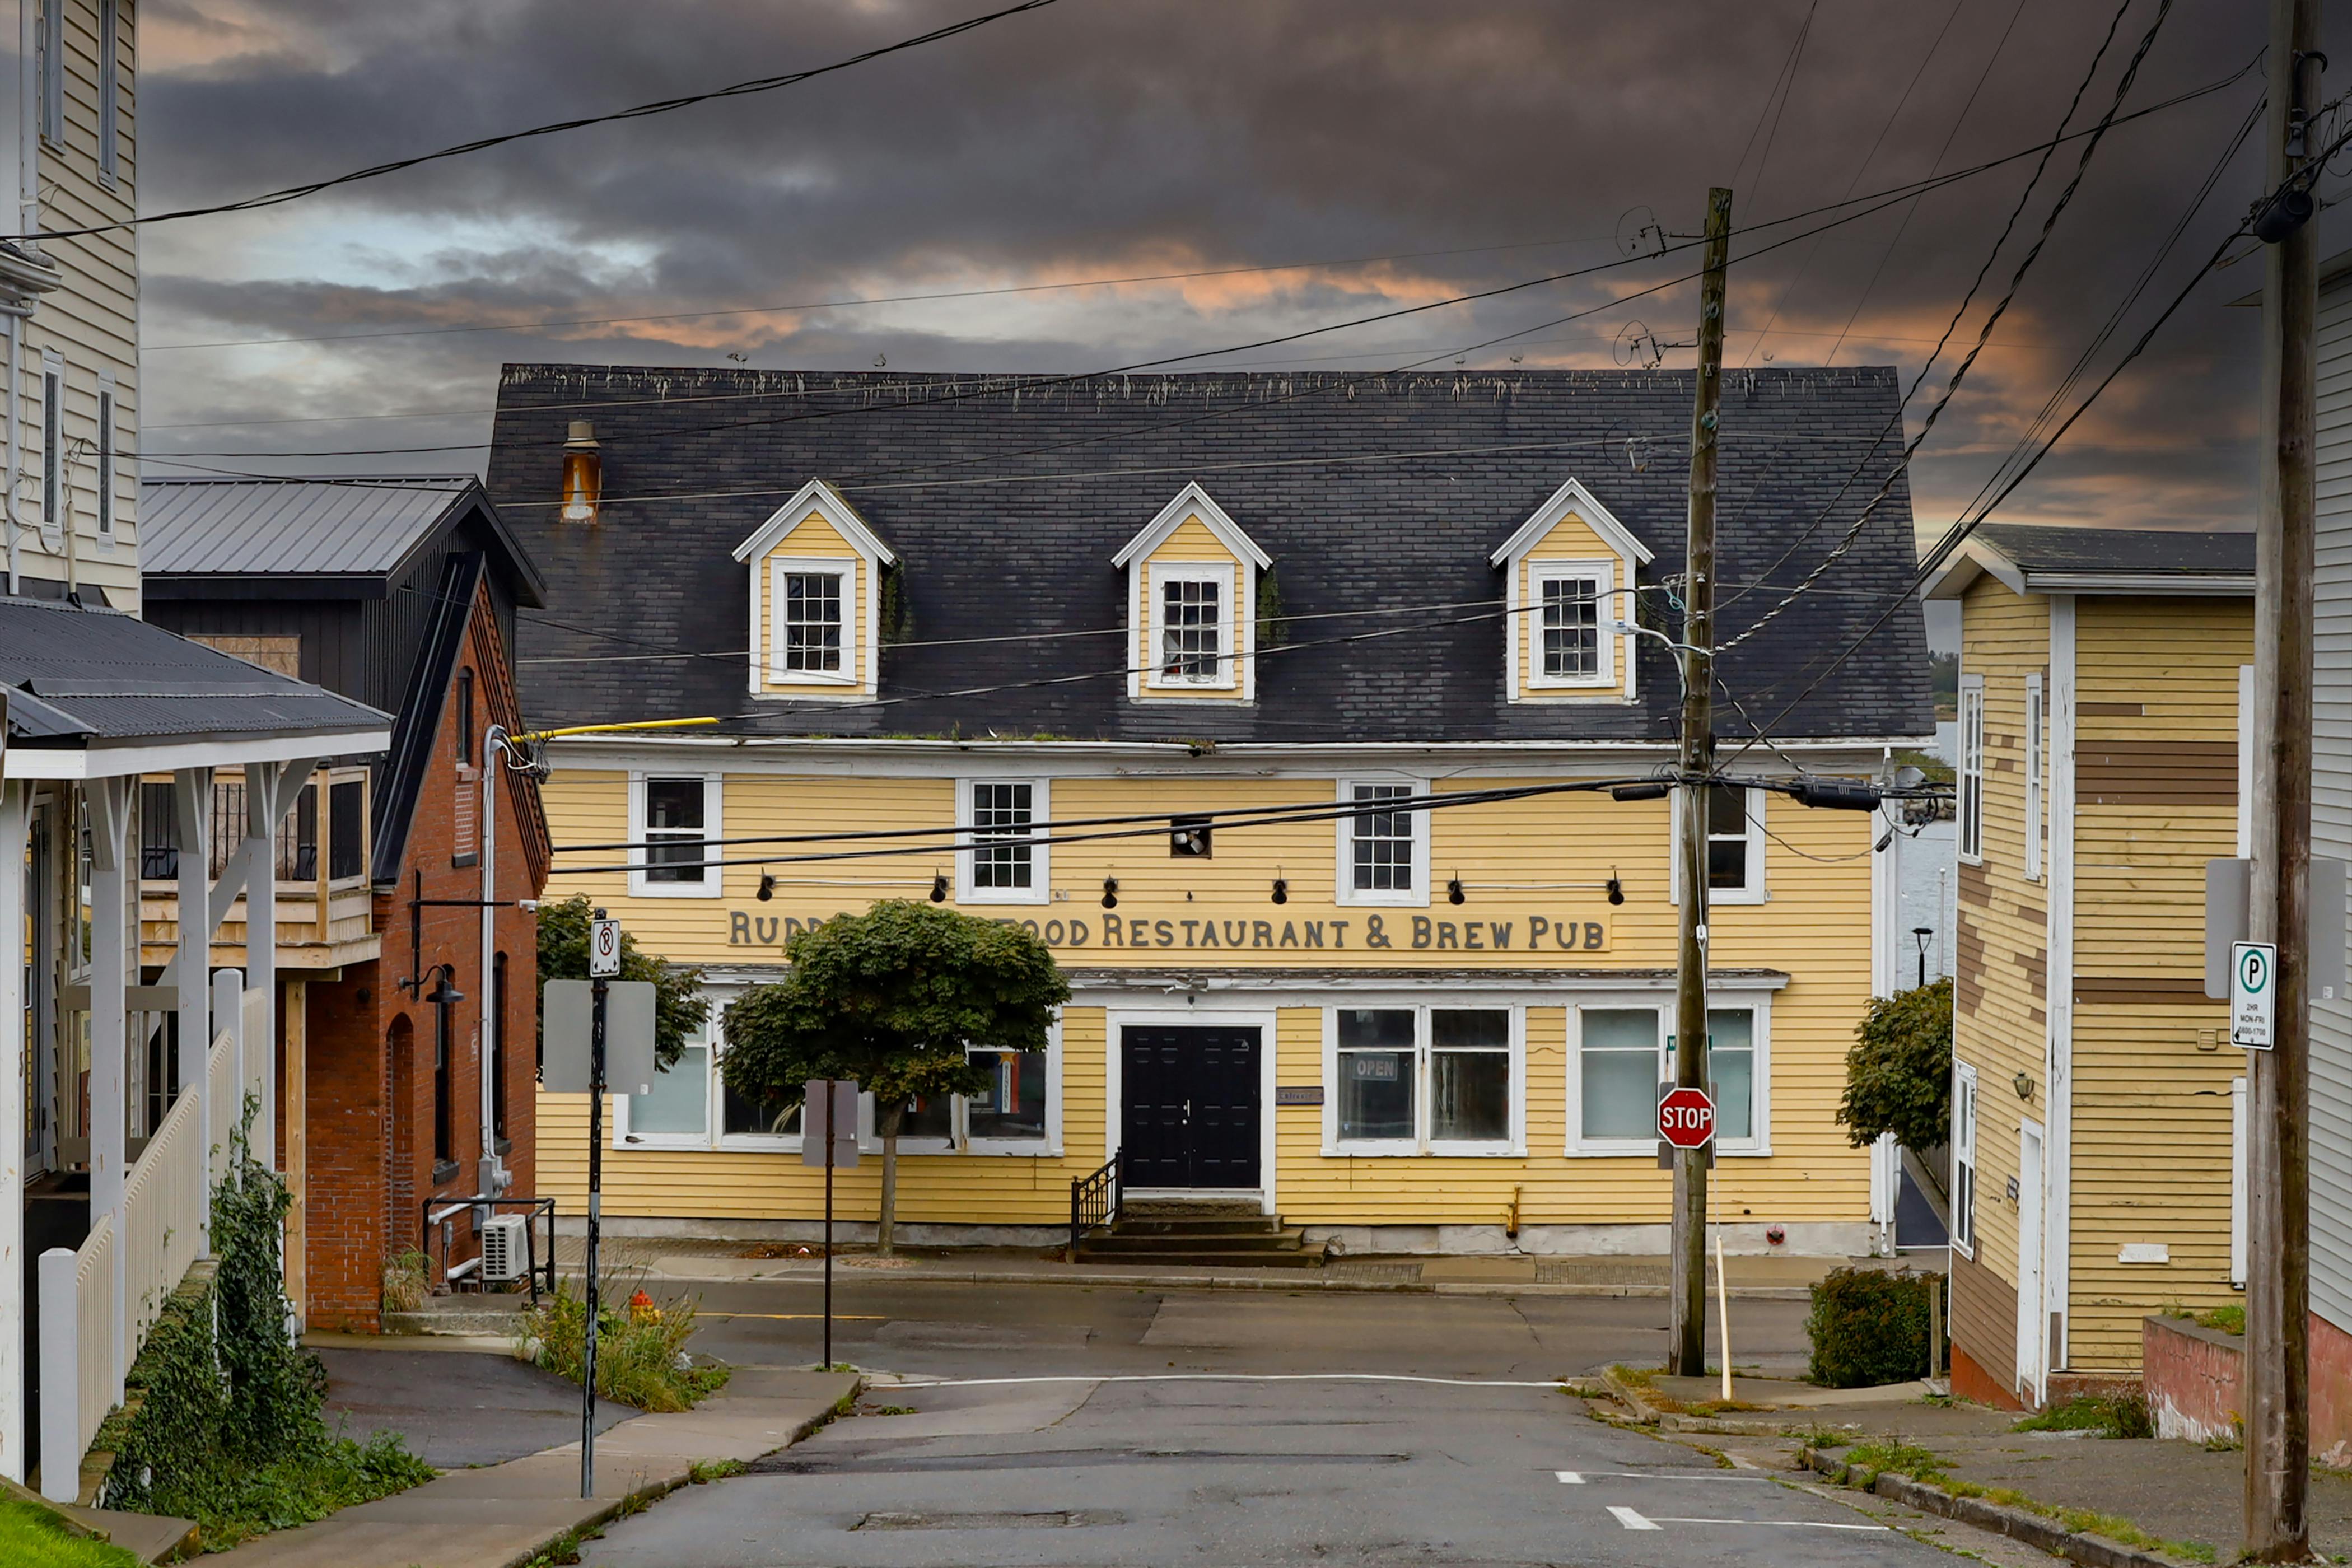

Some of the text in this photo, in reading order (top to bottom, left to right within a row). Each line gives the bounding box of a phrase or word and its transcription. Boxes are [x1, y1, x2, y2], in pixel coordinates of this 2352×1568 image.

[996, 918, 1089, 945] OOD
[1102, 913, 1349, 948] RESTAURANT
[1366, 914, 1392, 949] &
[1411, 916, 1513, 949] BREW
[1529, 916, 1603, 949] PUB
[2249, 958, 2259, 984] P
[2240, 1014, 2265, 1024] MON-FRI
[1357, 1060, 1394, 1077] OPEN
[1662, 1107, 1711, 1130] STOP
